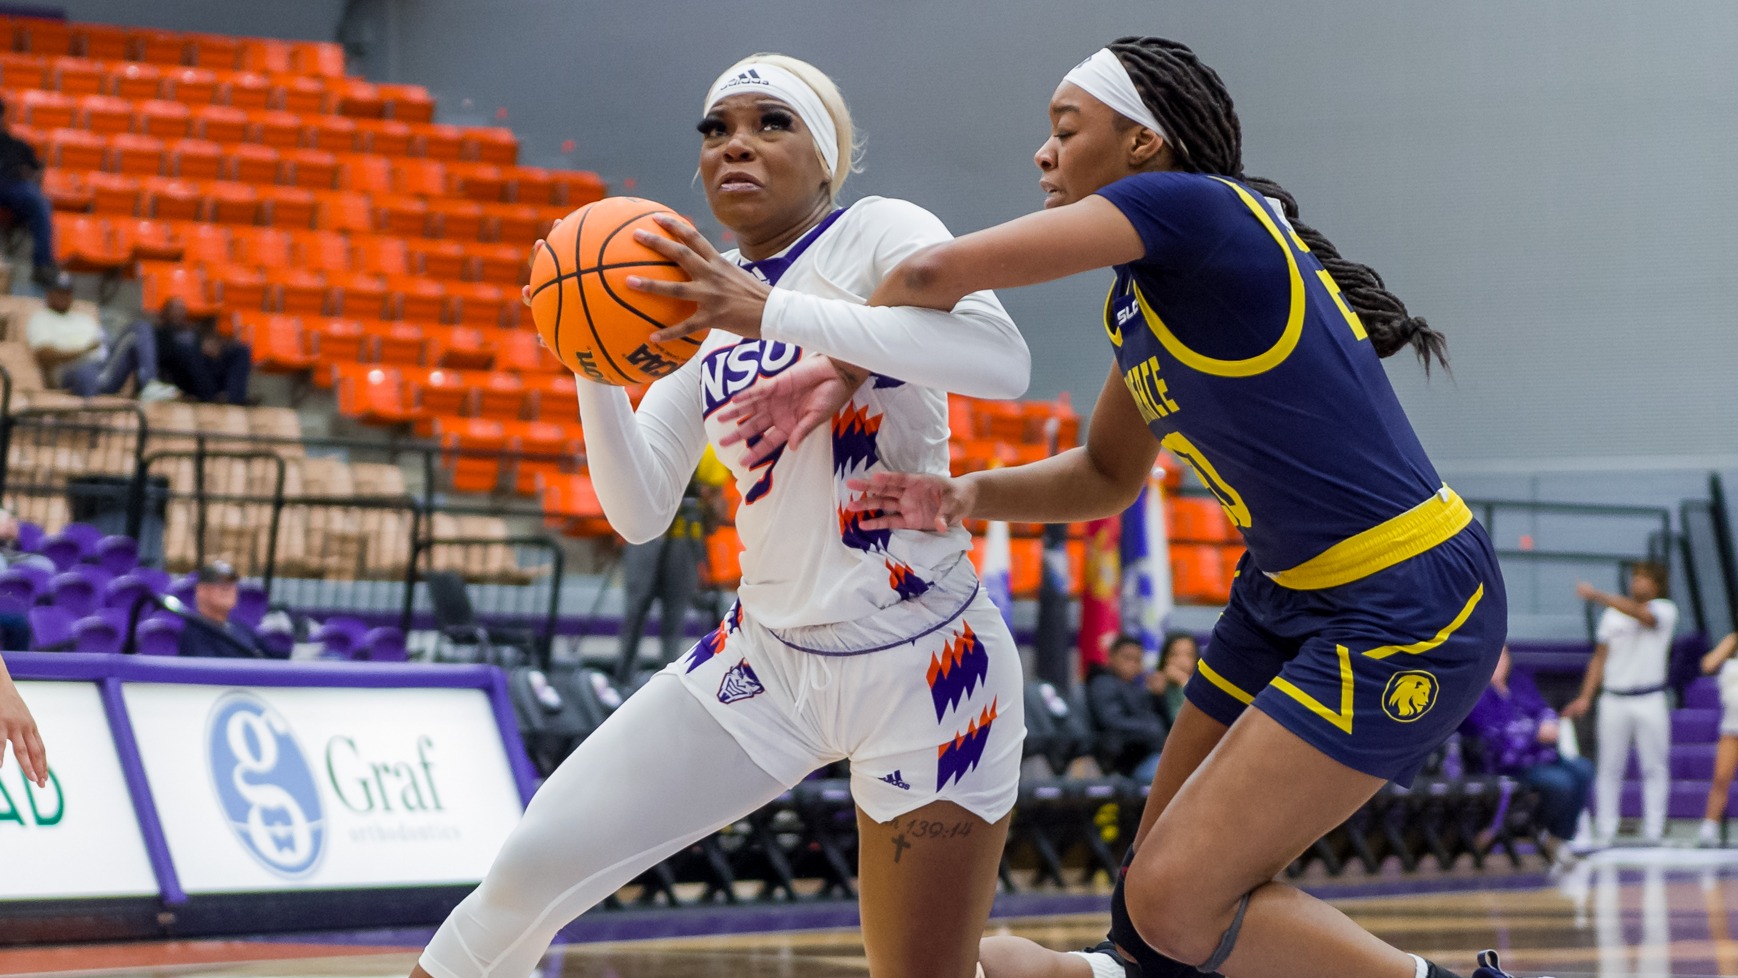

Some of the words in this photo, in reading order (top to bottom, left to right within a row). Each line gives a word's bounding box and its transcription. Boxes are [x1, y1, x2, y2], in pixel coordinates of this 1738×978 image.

[626, 343, 678, 377] CAA
[701, 340, 797, 412] NSU
[325, 734, 445, 814] Graf
[906, 819, 974, 838] 139:14
